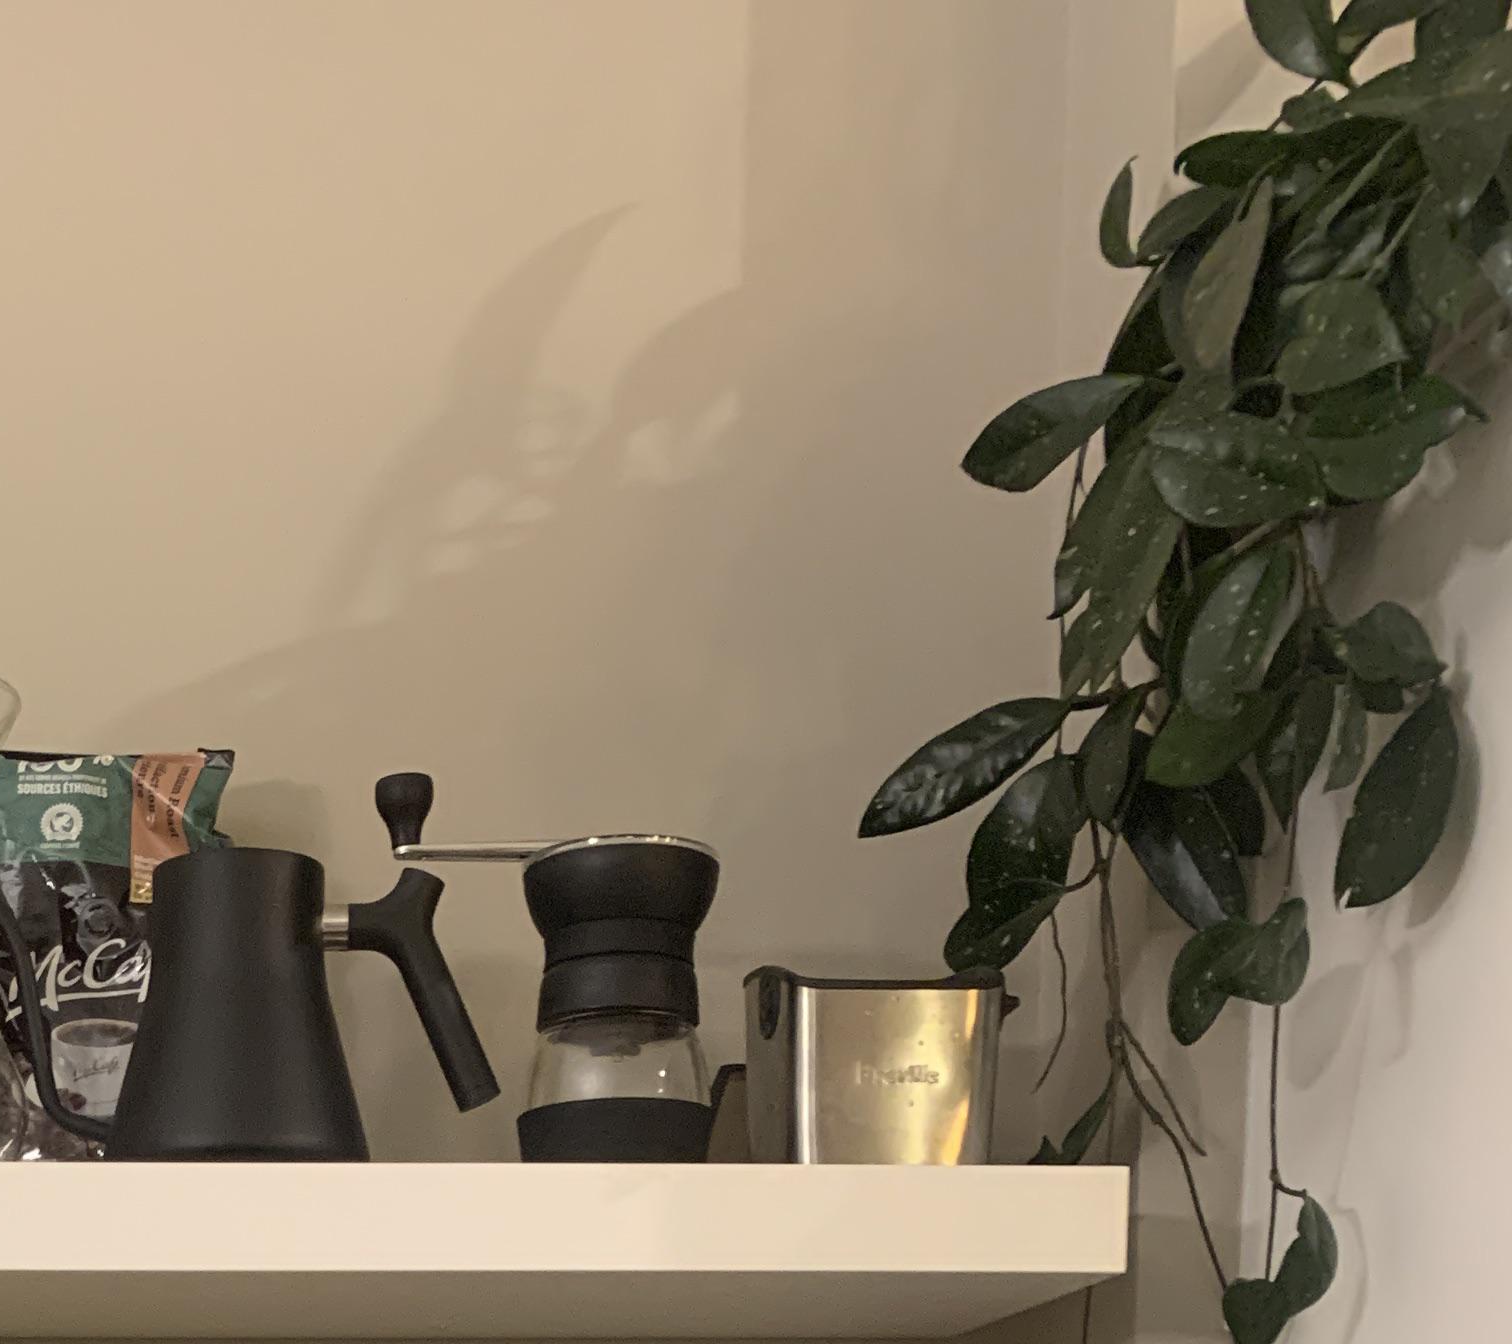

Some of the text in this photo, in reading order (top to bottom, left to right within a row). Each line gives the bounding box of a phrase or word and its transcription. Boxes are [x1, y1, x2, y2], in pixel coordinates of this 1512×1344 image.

[16, 781, 108, 798] SOURCES ÉTHIQUES
[6, 938, 153, 1018] McCaf
